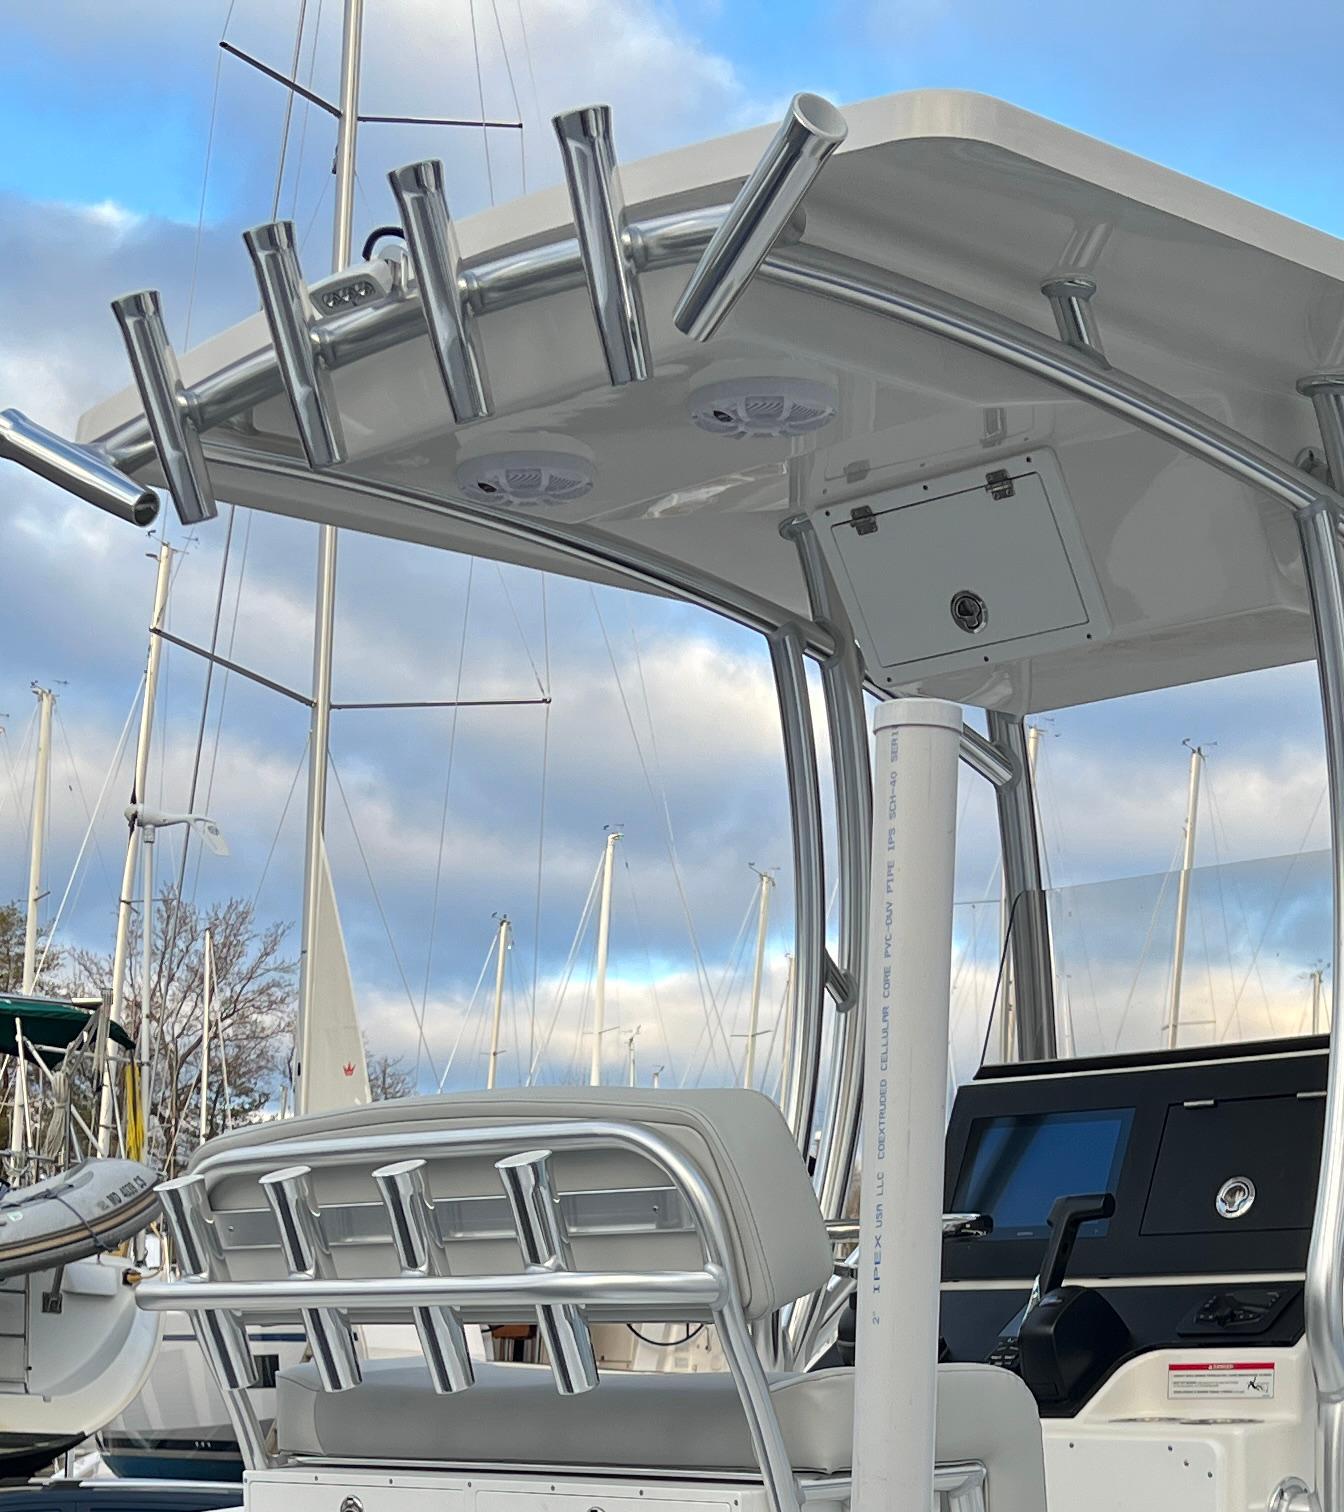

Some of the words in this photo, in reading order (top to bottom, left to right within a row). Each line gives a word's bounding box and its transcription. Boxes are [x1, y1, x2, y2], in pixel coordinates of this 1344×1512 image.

[889, 771, 898, 819] SCH-40
[887, 828, 897, 851] IPS
[886, 861, 896, 893] PIPE
[882, 966, 892, 998] CORE
[880, 1006, 890, 1071] CELLULAR
[877, 1079, 888, 1160] COEXTRUDED
[877, 1172, 885, 1196] LLC
[873, 1235, 882, 1293] IPEX
